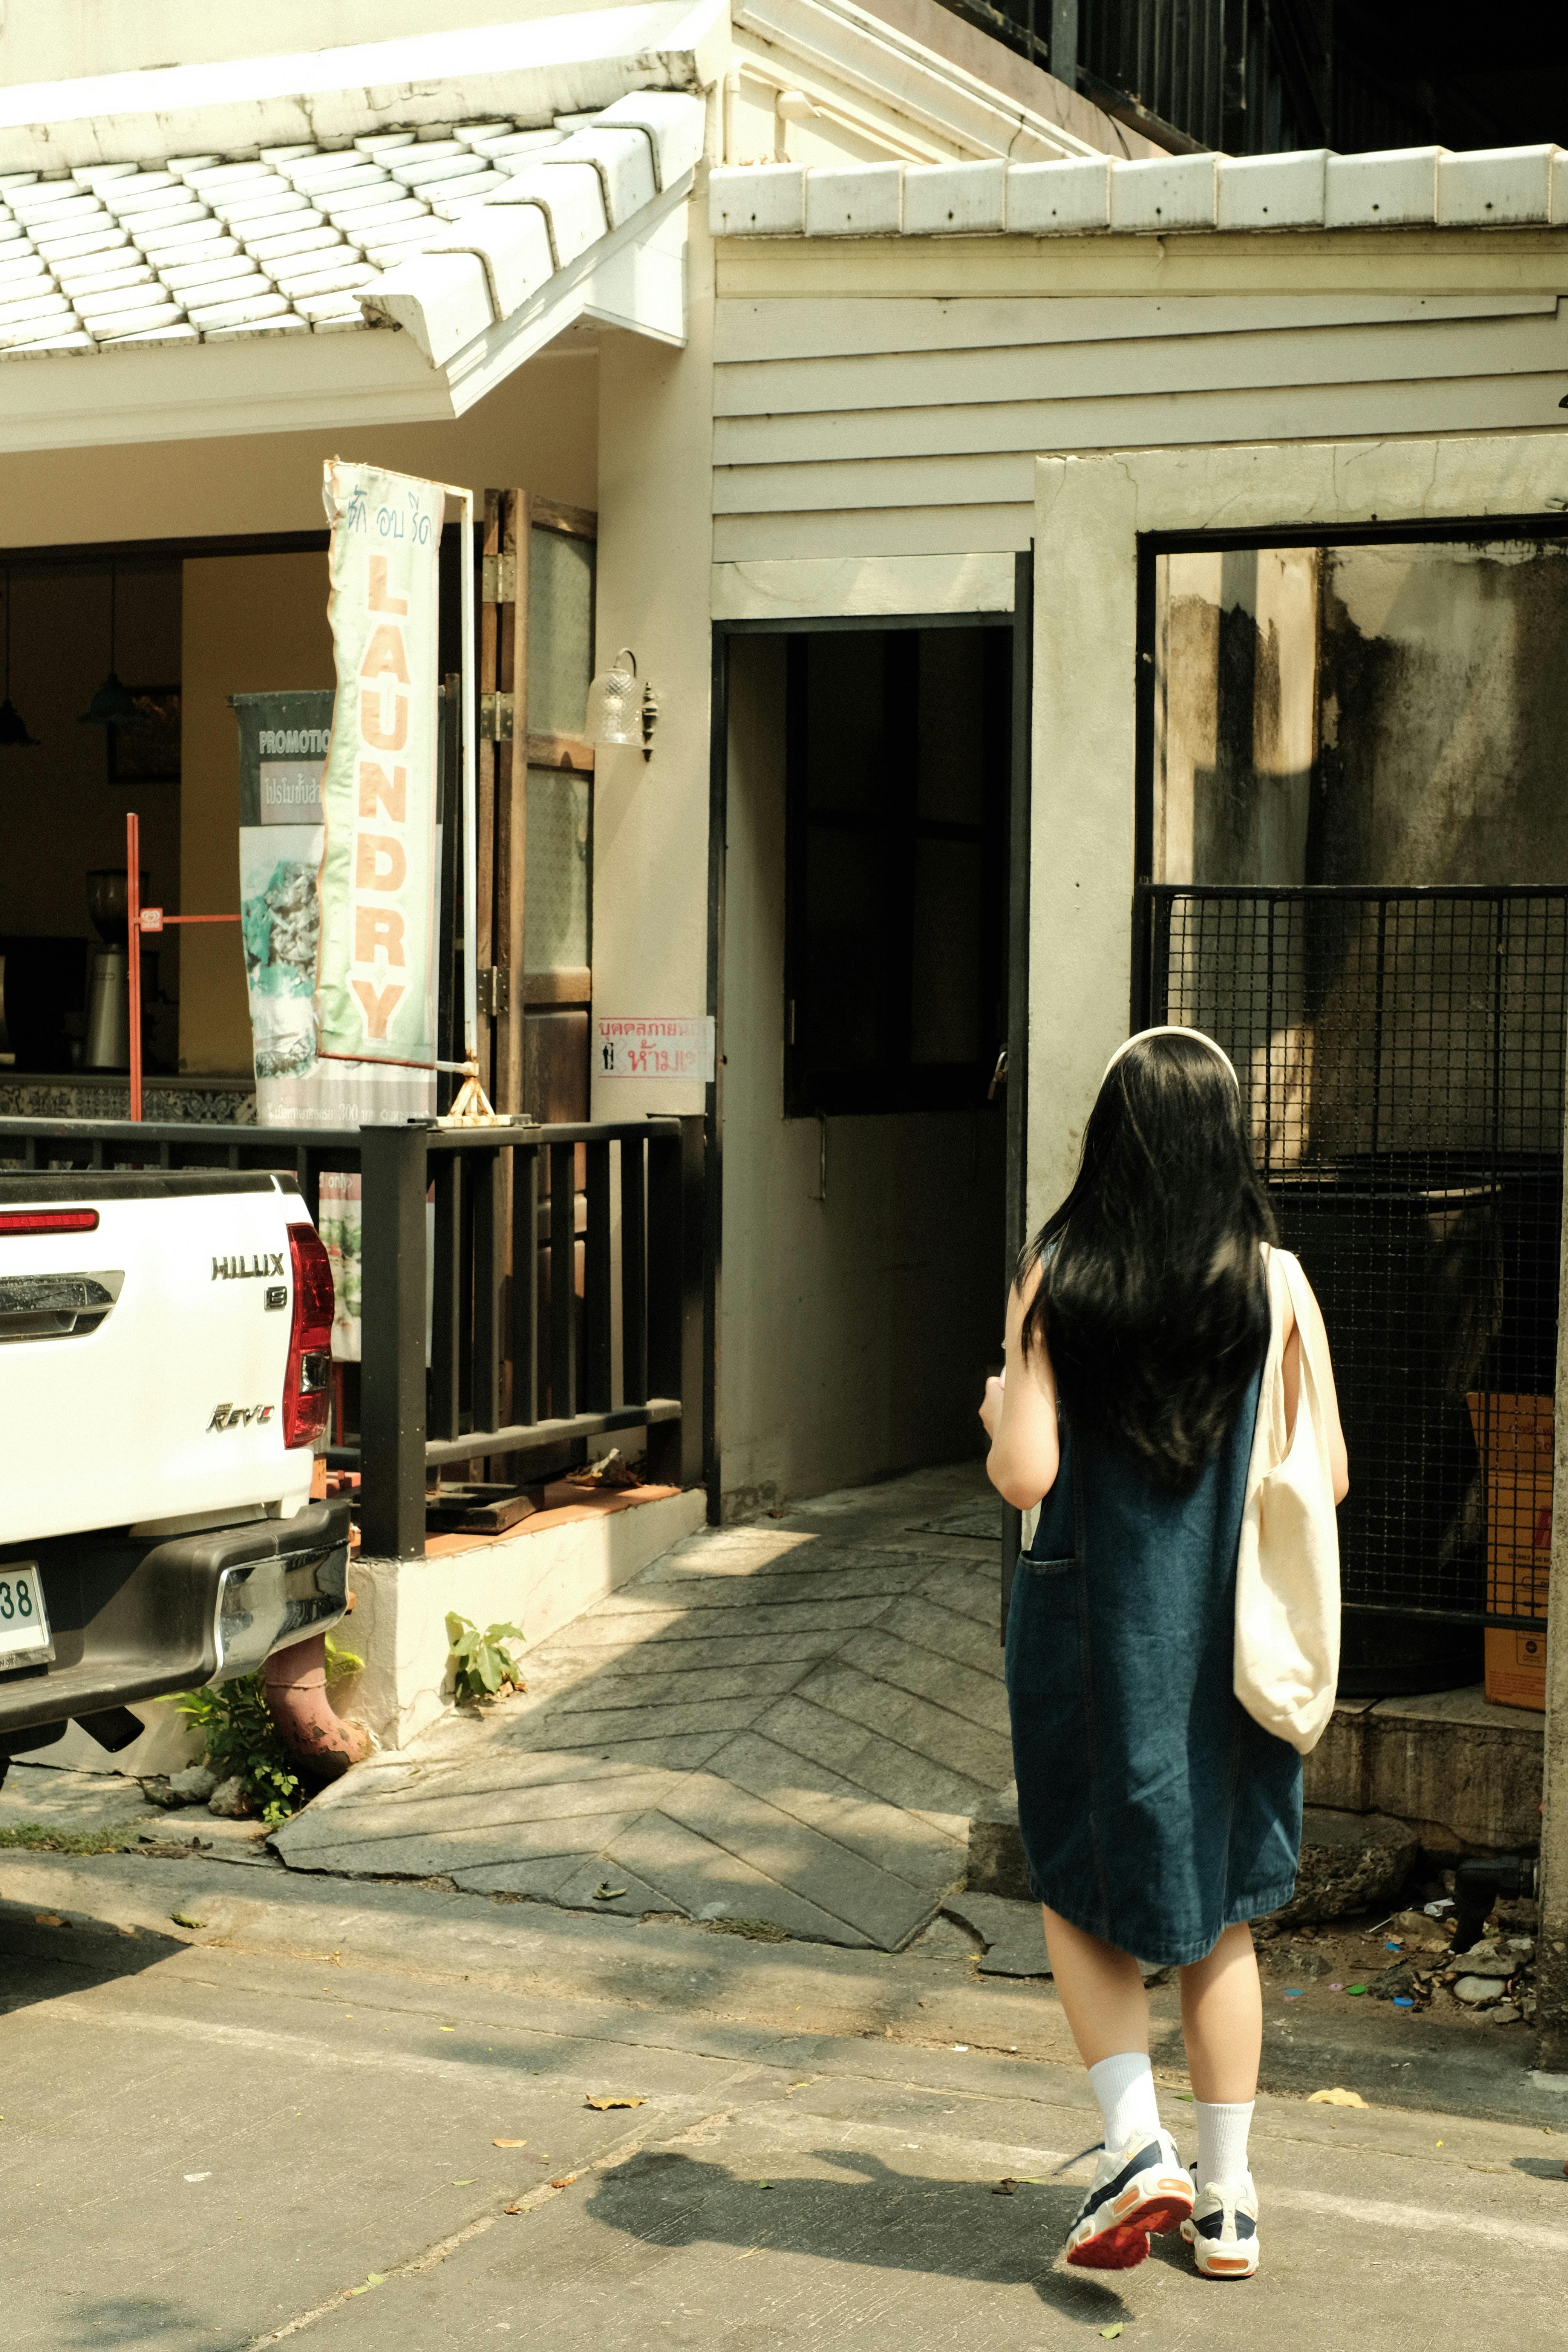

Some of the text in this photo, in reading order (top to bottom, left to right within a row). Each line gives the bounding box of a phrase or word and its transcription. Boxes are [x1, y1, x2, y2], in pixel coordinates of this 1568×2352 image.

[377, 507, 404, 538] อบ
[259, 729, 331, 754] PROMOTIO
[351, 554, 411, 1040] LAUNDRY
[599, 1022, 706, 1041] บุคคลภายน
[338, 1102, 359, 1121] 300
[211, 1252, 285, 1281] HILUX
[0, 1580, 32, 1619] 38
